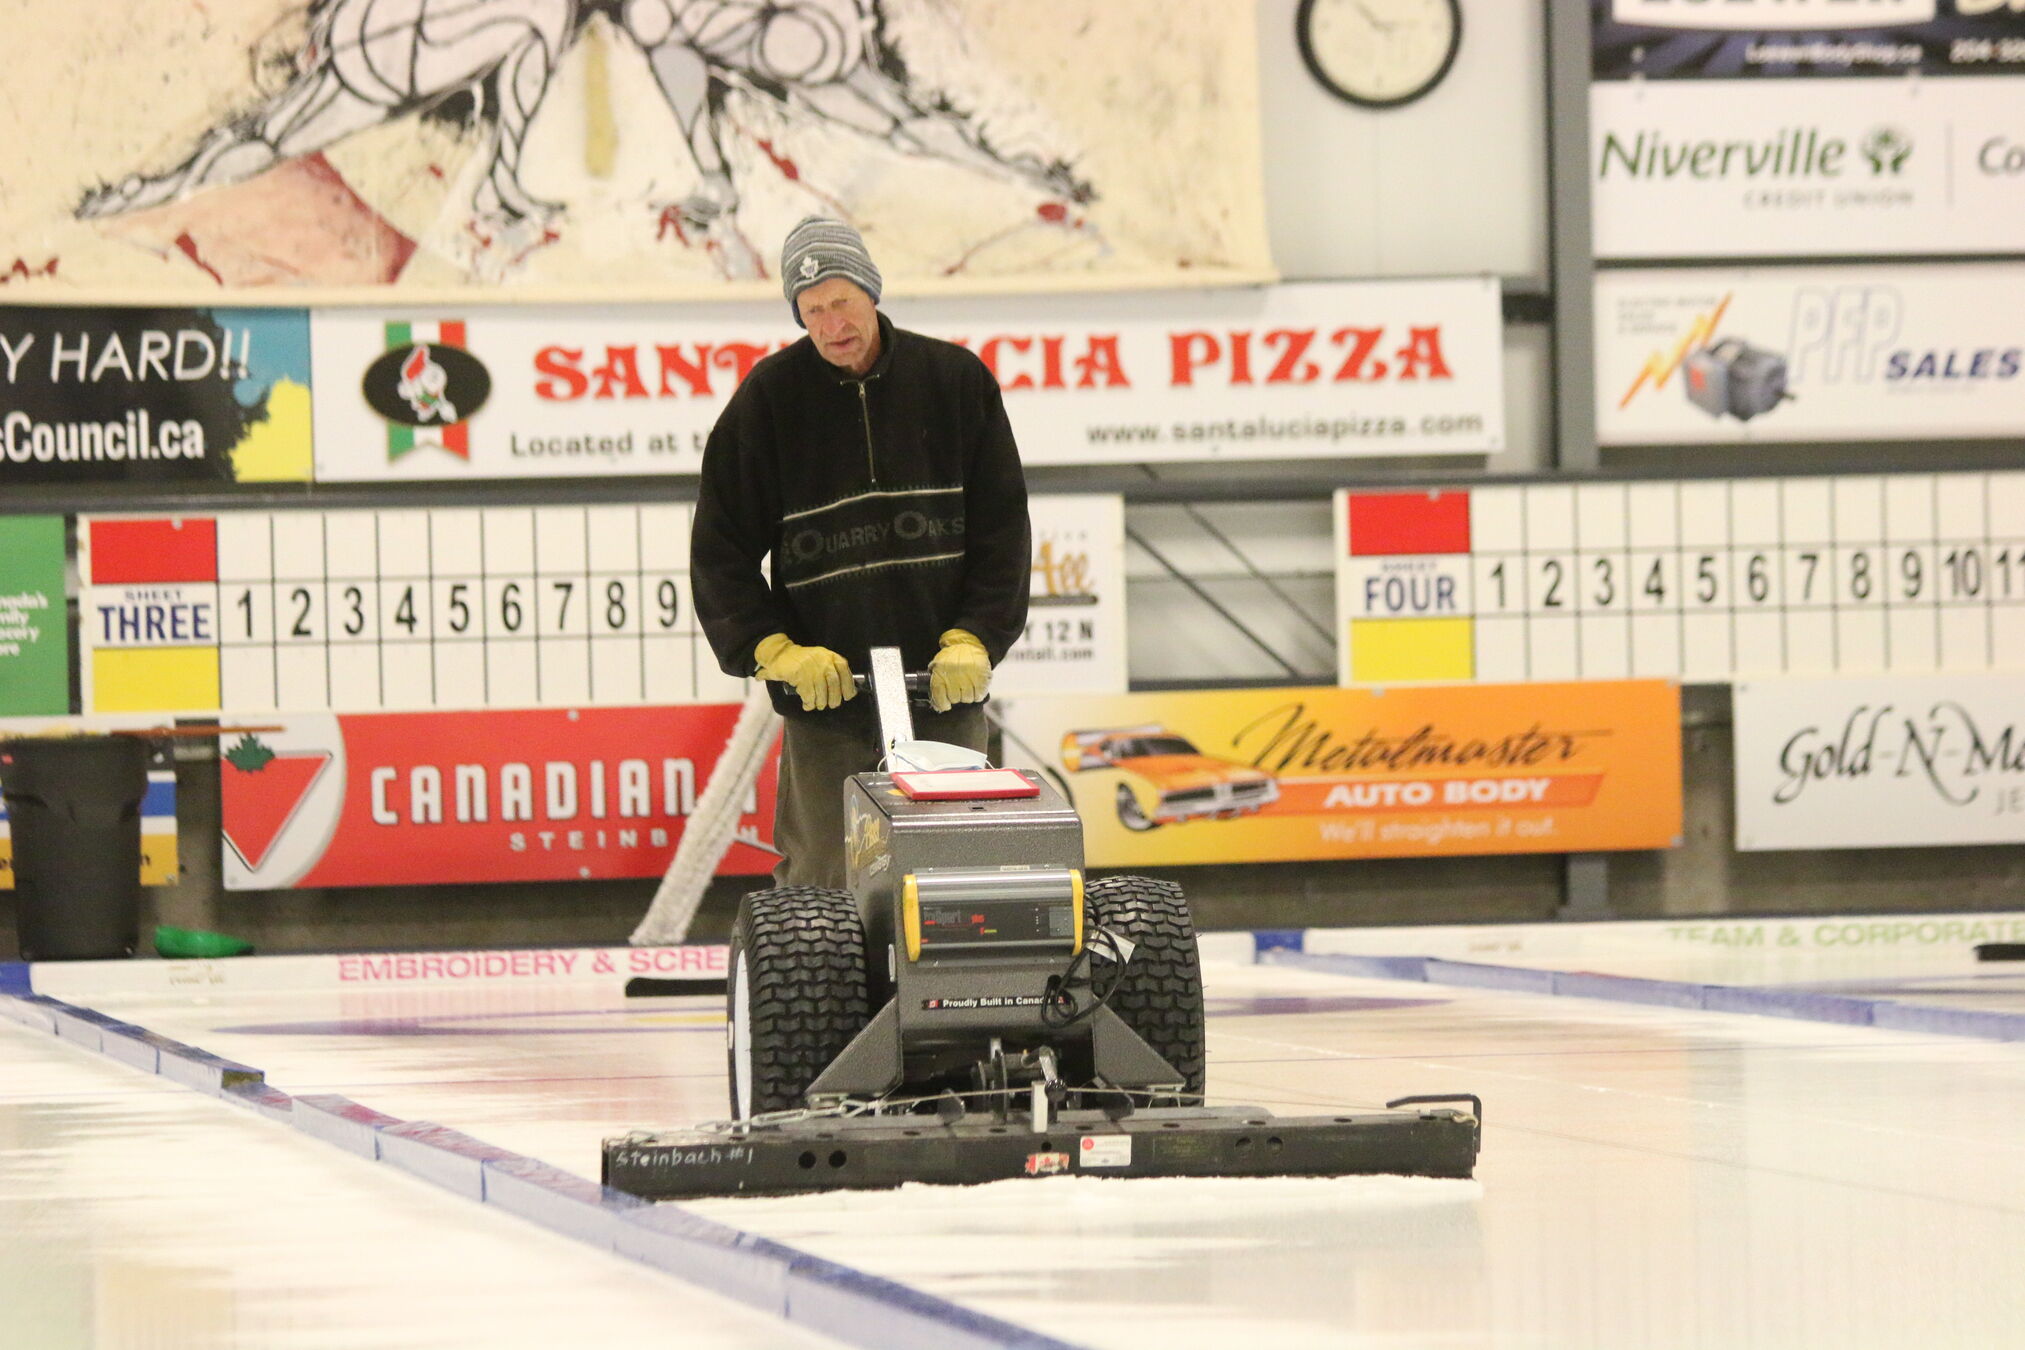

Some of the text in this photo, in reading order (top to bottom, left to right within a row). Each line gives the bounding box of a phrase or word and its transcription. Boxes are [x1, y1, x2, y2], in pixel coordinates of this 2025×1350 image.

[1599, 127, 1847, 180] Niverville
[51, 328, 250, 383] HARD!!
[533, 323, 1454, 402] SANT CIA PIZZA
[1885, 347, 2023, 380] SALES
[0, 408, 205, 462] Council.ca
[511, 431, 634, 457] Located
[649, 432, 675, 452] at
[791, 510, 966, 560] QUARRY OAKS
[1365, 573, 1457, 613] FOUR
[1491, 562, 1505, 608] 1
[1542, 559, 1563, 609] 2
[1594, 557, 1615, 607] 3
[1643, 557, 1667, 605] 4
[1697, 554, 1718, 604] 5
[1747, 553, 1769, 603] 6
[1799, 551, 1819, 600] 7
[1850, 550, 1872, 601] 8
[1901, 549, 1923, 600] 9
[1944, 549, 1982, 597] 10
[97, 603, 211, 641] THREE
[237, 579, 679, 639] 1 2 3 4 5 6 7 8 9
[1046, 619, 1071, 642] 12
[1232, 703, 1613, 774] Metalmaster
[370, 758, 697, 826] CANADIAN
[1324, 778, 1552, 808] AUTO BODY
[1664, 925, 1765, 948] TEAM
[1776, 926, 1802, 947] &
[338, 945, 728, 982] EMBROIDERY & SCRE
[943, 999, 977, 1009] Proudly
[980, 997, 1001, 1007] Built
[1005, 997, 1013, 1006] in
[616, 1148, 722, 1168] Steinbach
